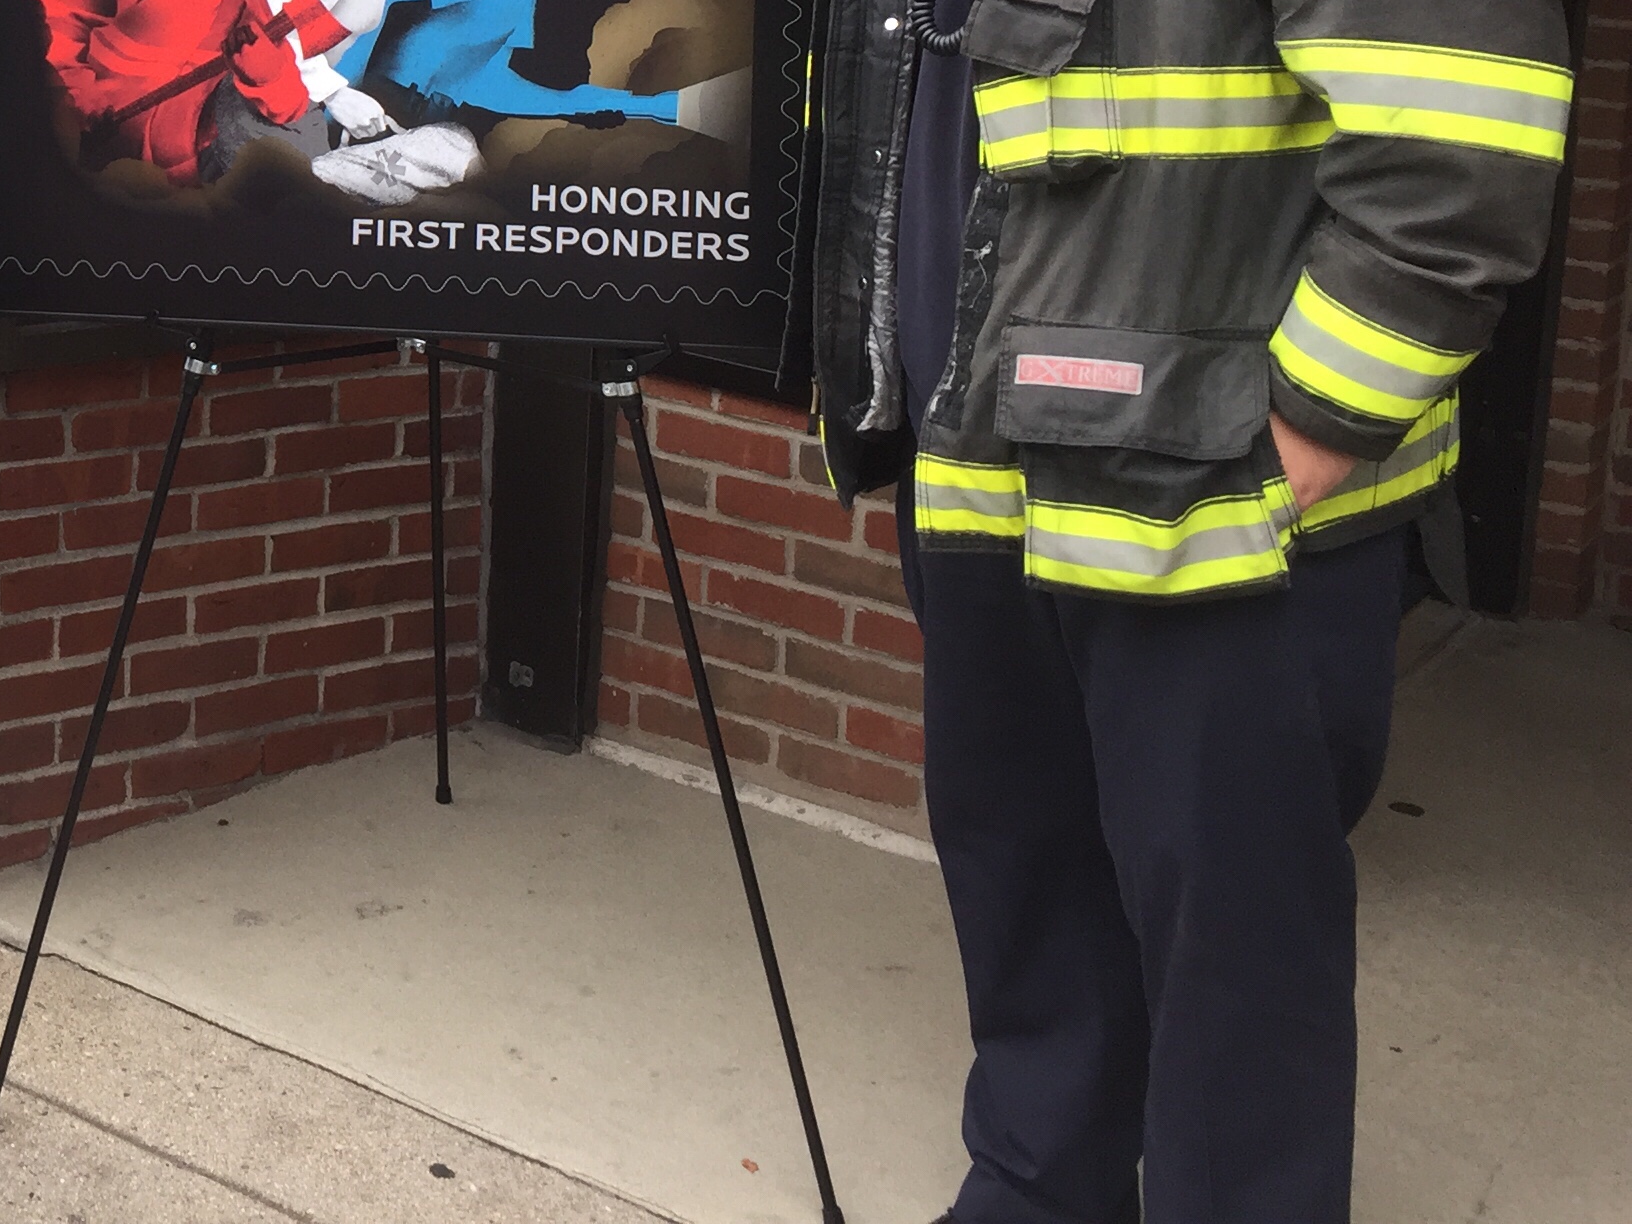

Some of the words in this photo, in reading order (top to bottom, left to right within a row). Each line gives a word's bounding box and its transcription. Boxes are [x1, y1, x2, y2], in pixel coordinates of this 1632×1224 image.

[531, 184, 750, 220] HONORING
[352, 218, 465, 250] FIRST
[476, 223, 750, 262] RESPONDERS
